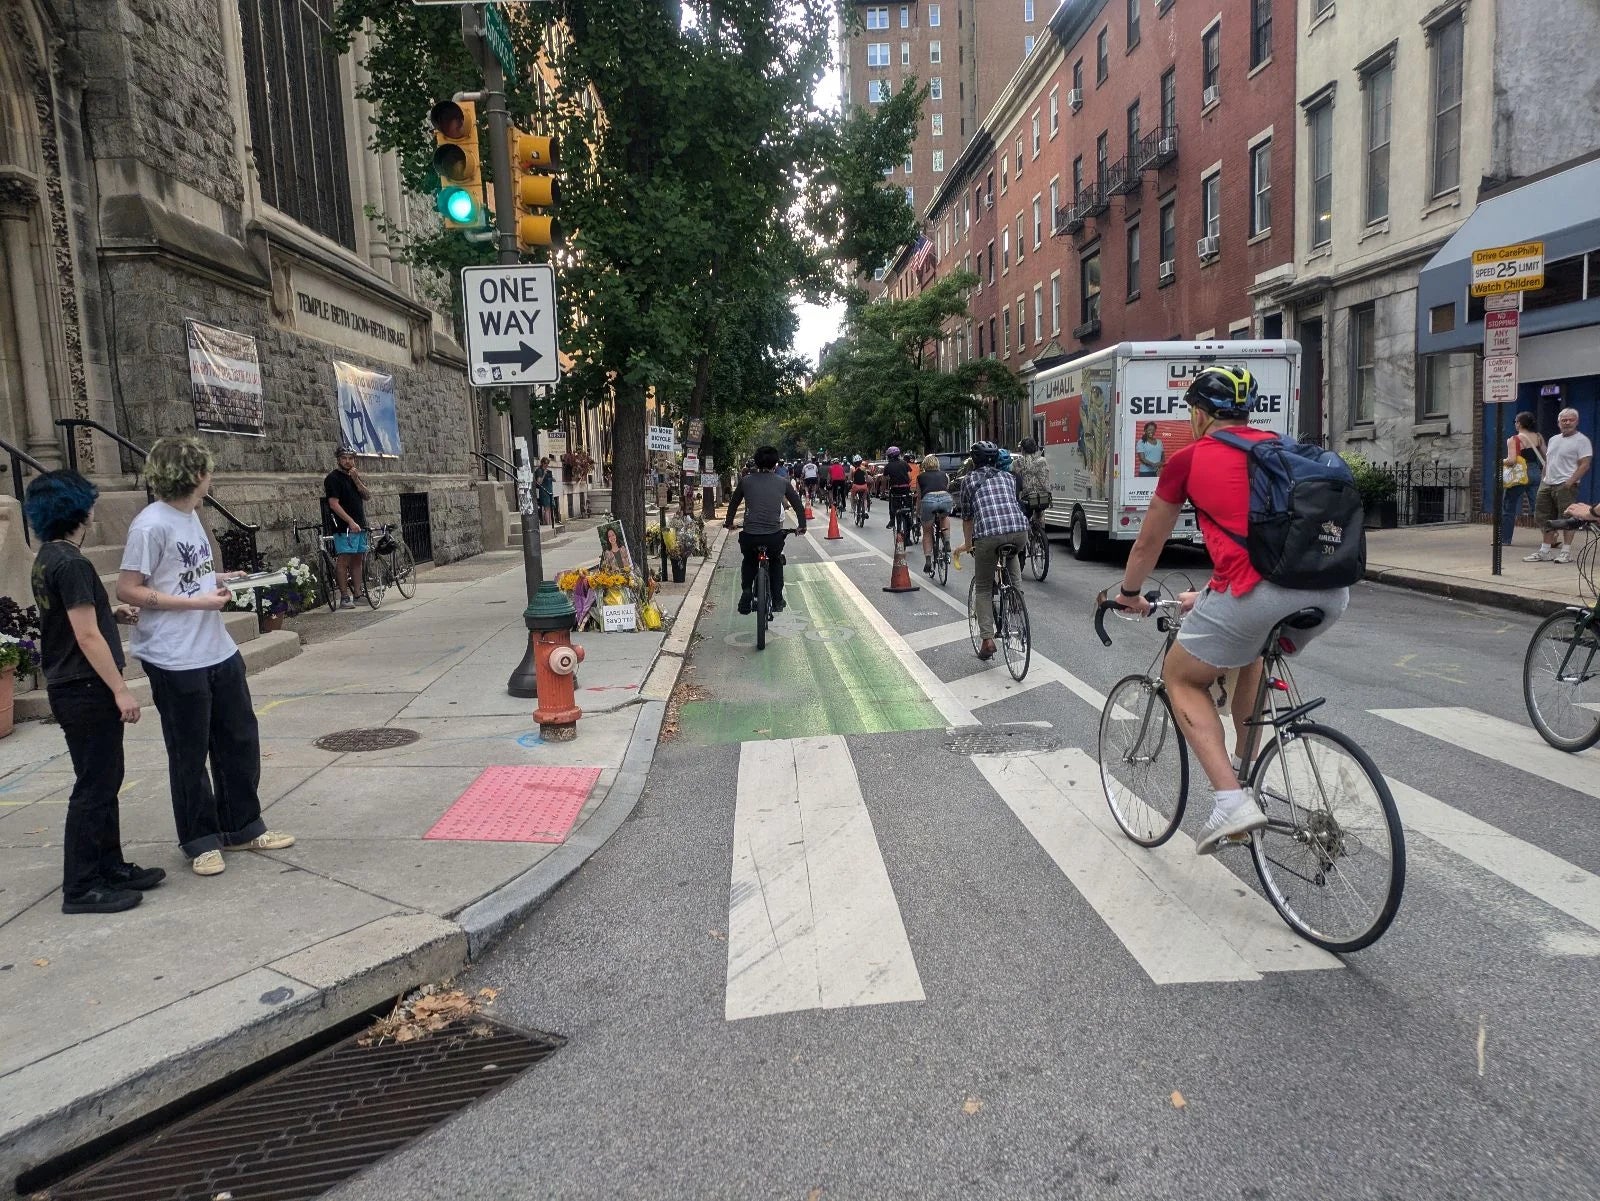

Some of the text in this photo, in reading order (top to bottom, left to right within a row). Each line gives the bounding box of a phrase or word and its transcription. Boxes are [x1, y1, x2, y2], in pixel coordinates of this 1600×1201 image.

[1476, 245, 1539, 262] Drive CarePhilly
[1475, 260, 1540, 278] SPEED 25 LIMIT
[480, 277, 539, 304] ONE
[1474, 278, 1541, 293] Watch Children
[297, 291, 329, 320] TEMPLE
[330, 303, 350, 329] BETH
[387, 327, 408, 349] ISRAEL
[479, 309, 541, 336] WAY
[1488, 319, 1516, 328] STOPPING
[1494, 329, 1509, 338] ANY
[1493, 338, 1510, 346] TIME
[1488, 358, 1513, 367] LOADING
[1493, 365, 1508, 373] ONLY
